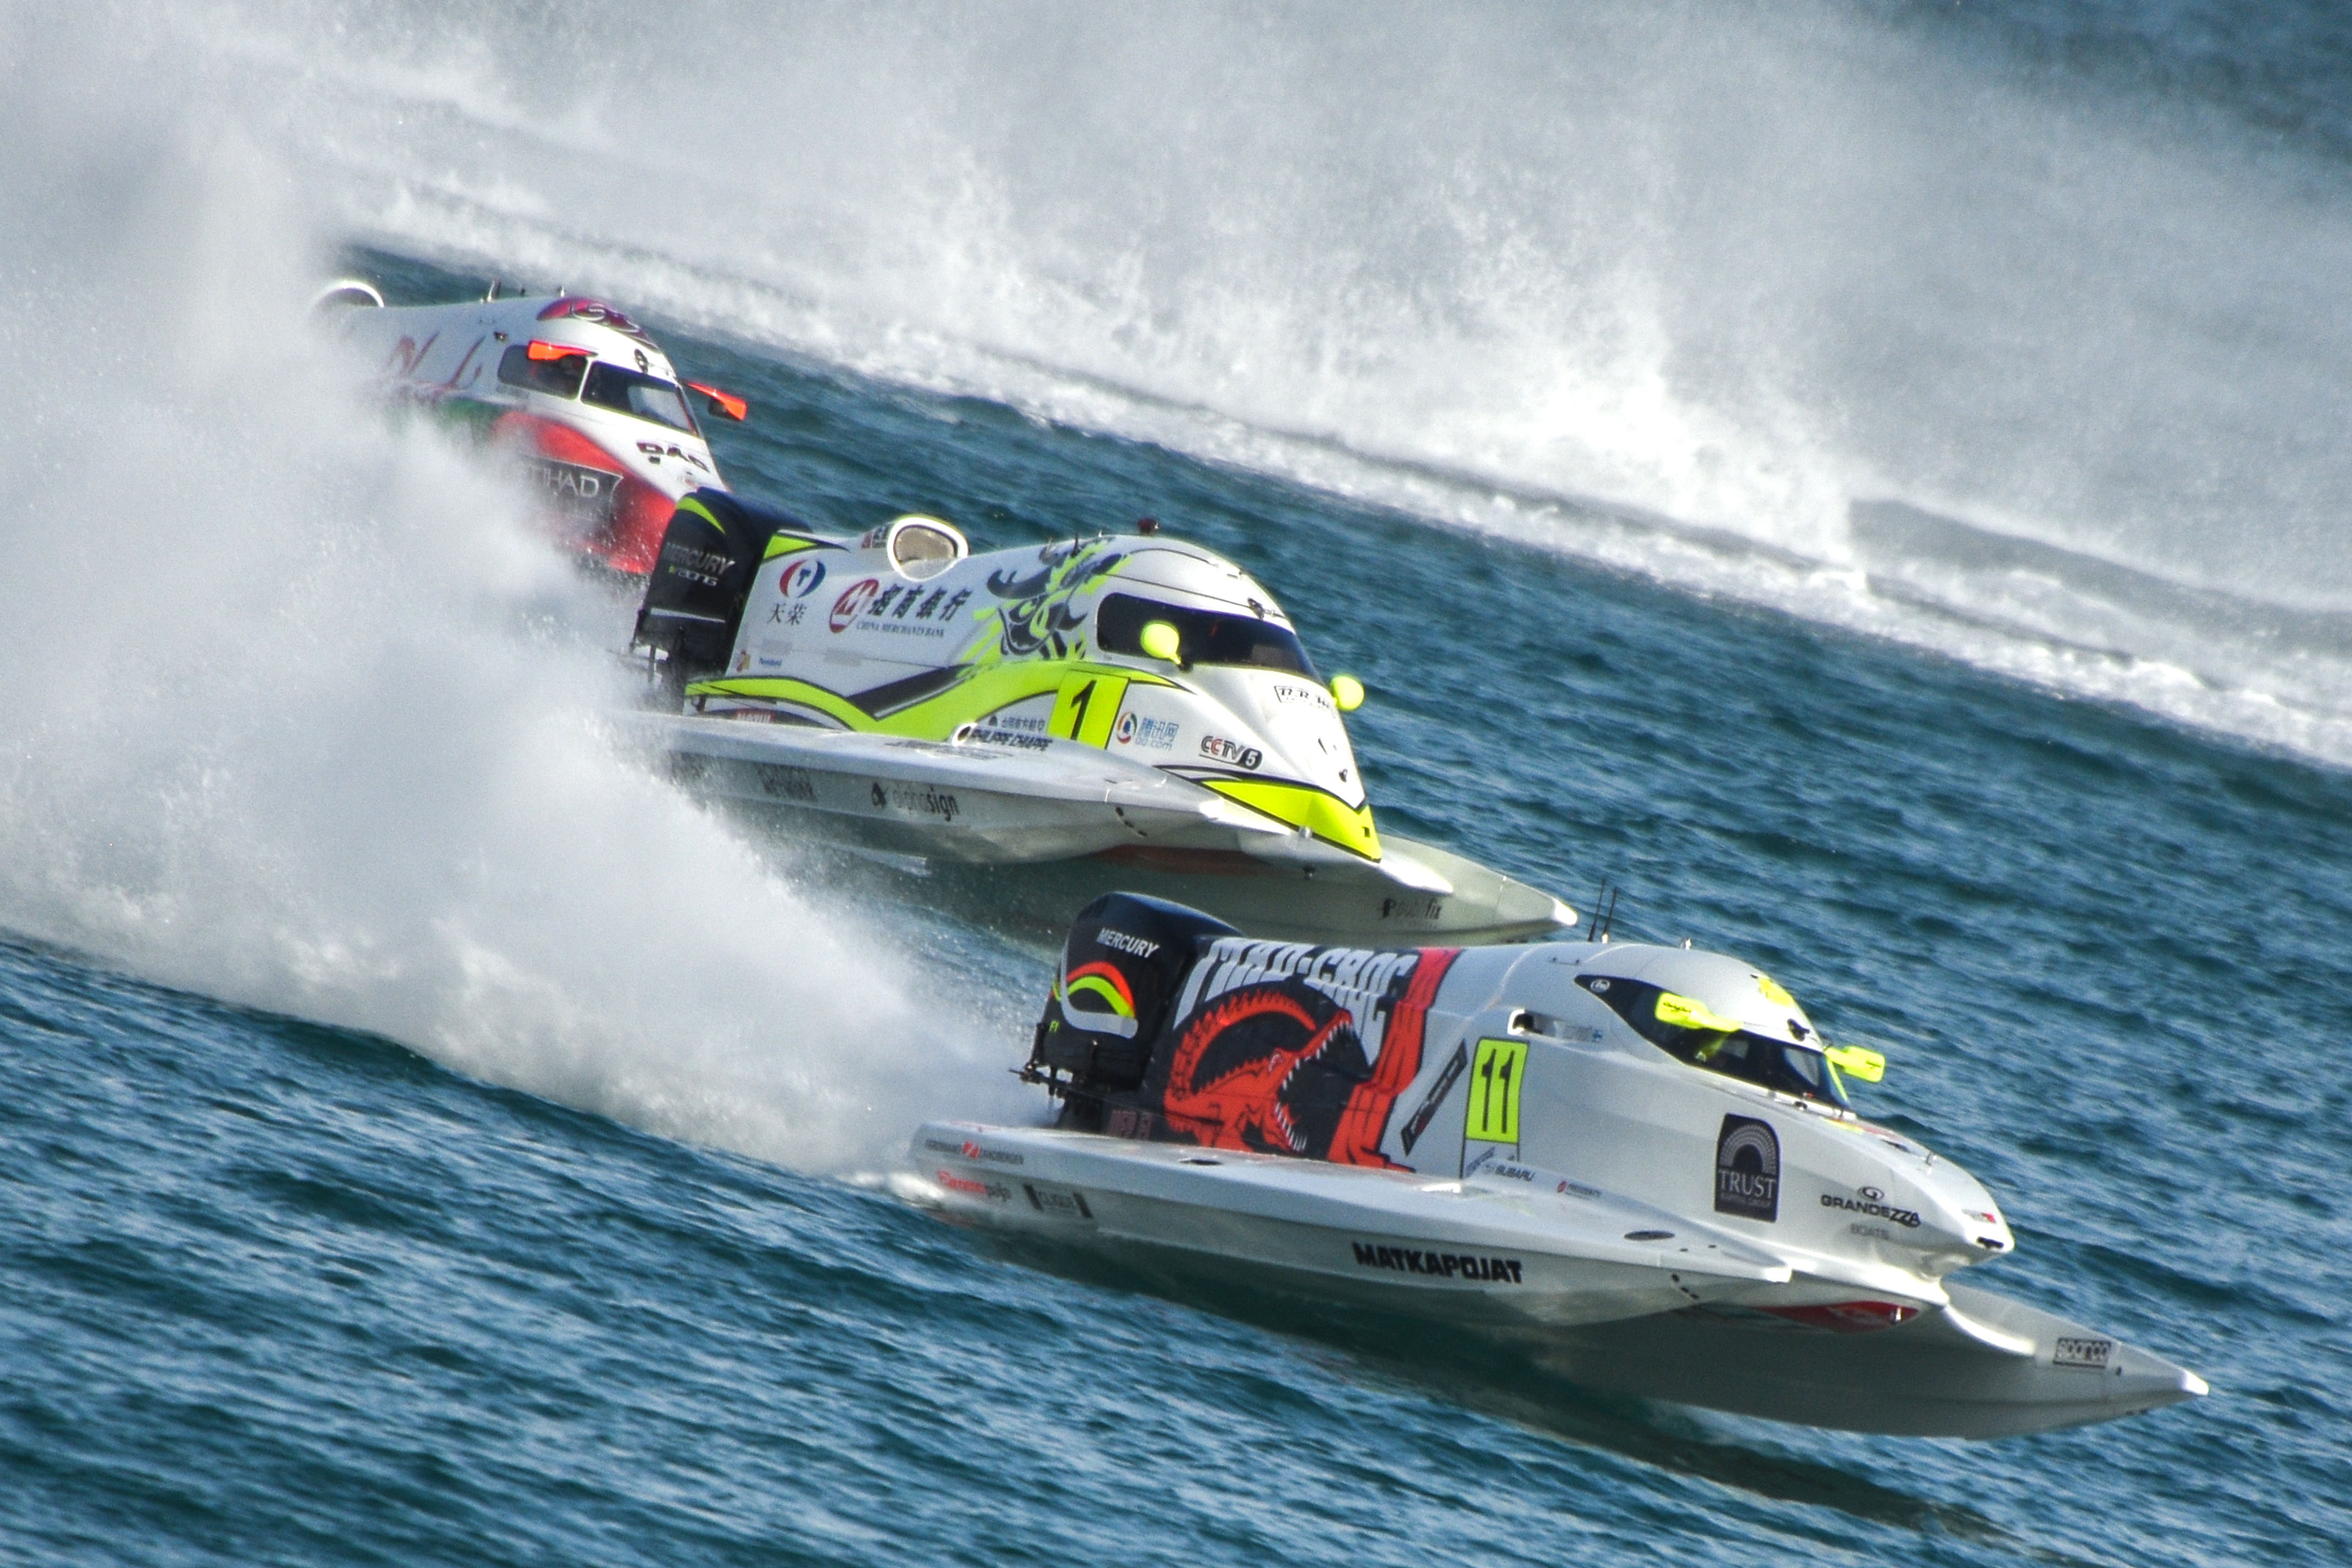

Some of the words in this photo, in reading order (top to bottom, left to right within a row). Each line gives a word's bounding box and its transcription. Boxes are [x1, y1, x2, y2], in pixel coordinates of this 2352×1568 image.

[1070, 679, 1097, 741] 1
[1096, 927, 1160, 958] MERCURY
[1481, 1048, 1515, 1134] 11
[1495, 1164, 1536, 1182] SUBARU
[1718, 1168, 1777, 1199] TRUST
[1821, 1194, 1921, 1228] GRANDEZZA
[1352, 1242, 1523, 1283] MATKAPOJAT
